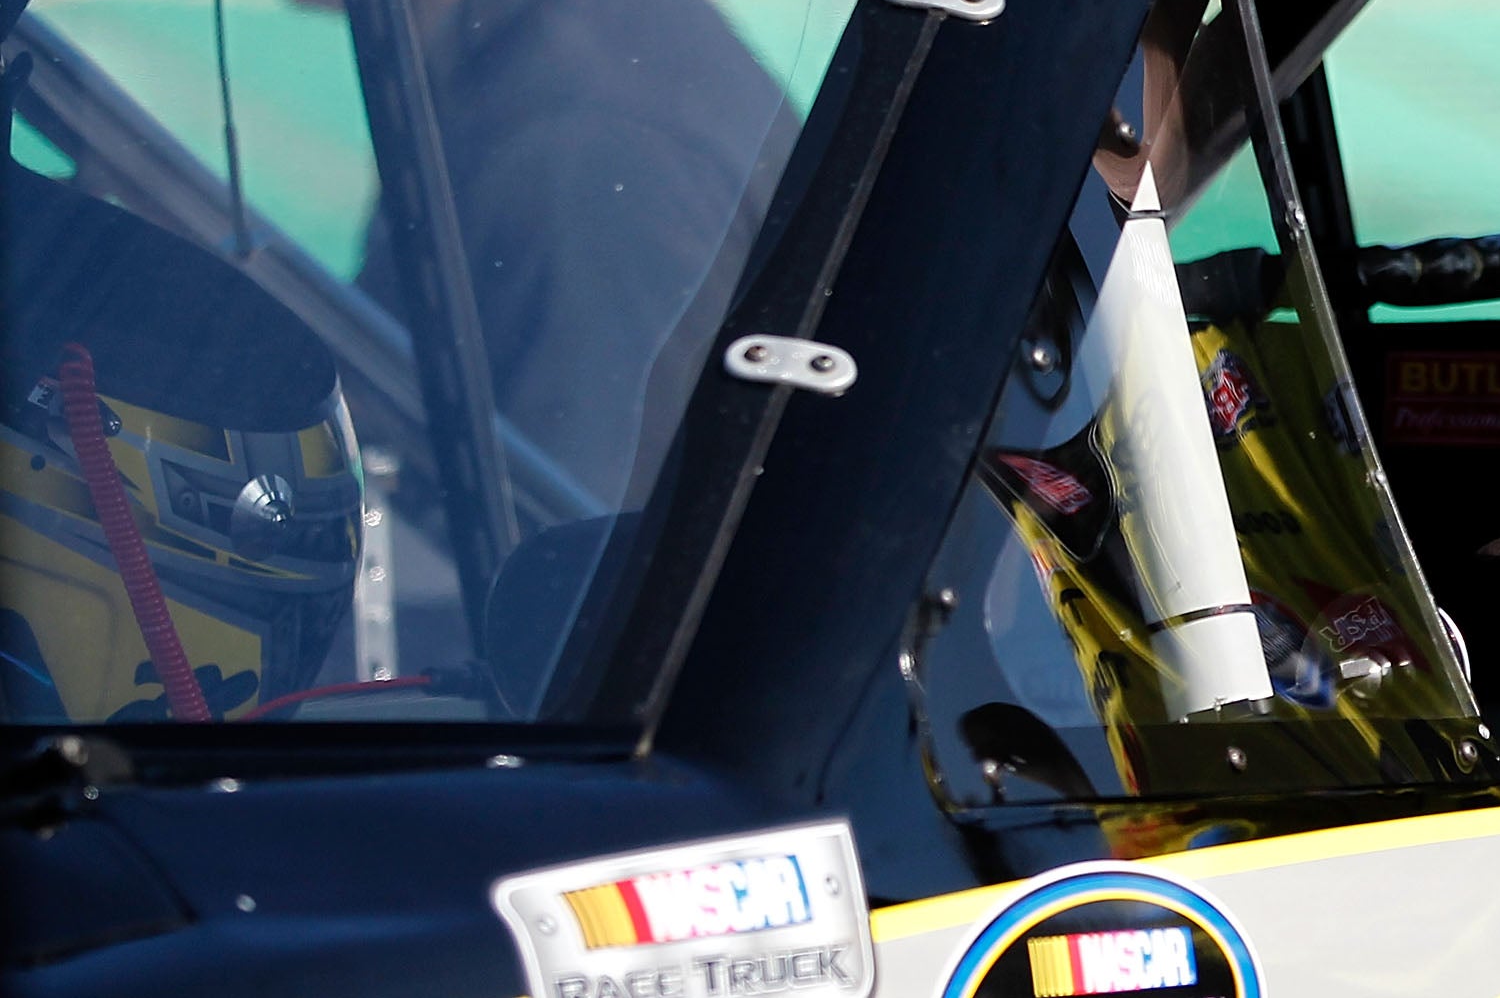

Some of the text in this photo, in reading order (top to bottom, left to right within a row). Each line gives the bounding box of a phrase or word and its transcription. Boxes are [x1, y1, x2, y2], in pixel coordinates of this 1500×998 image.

[632, 855, 812, 942] NASCAR
[692, 943, 857, 995] TRUCK
[1078, 928, 1194, 992] NASCAR
